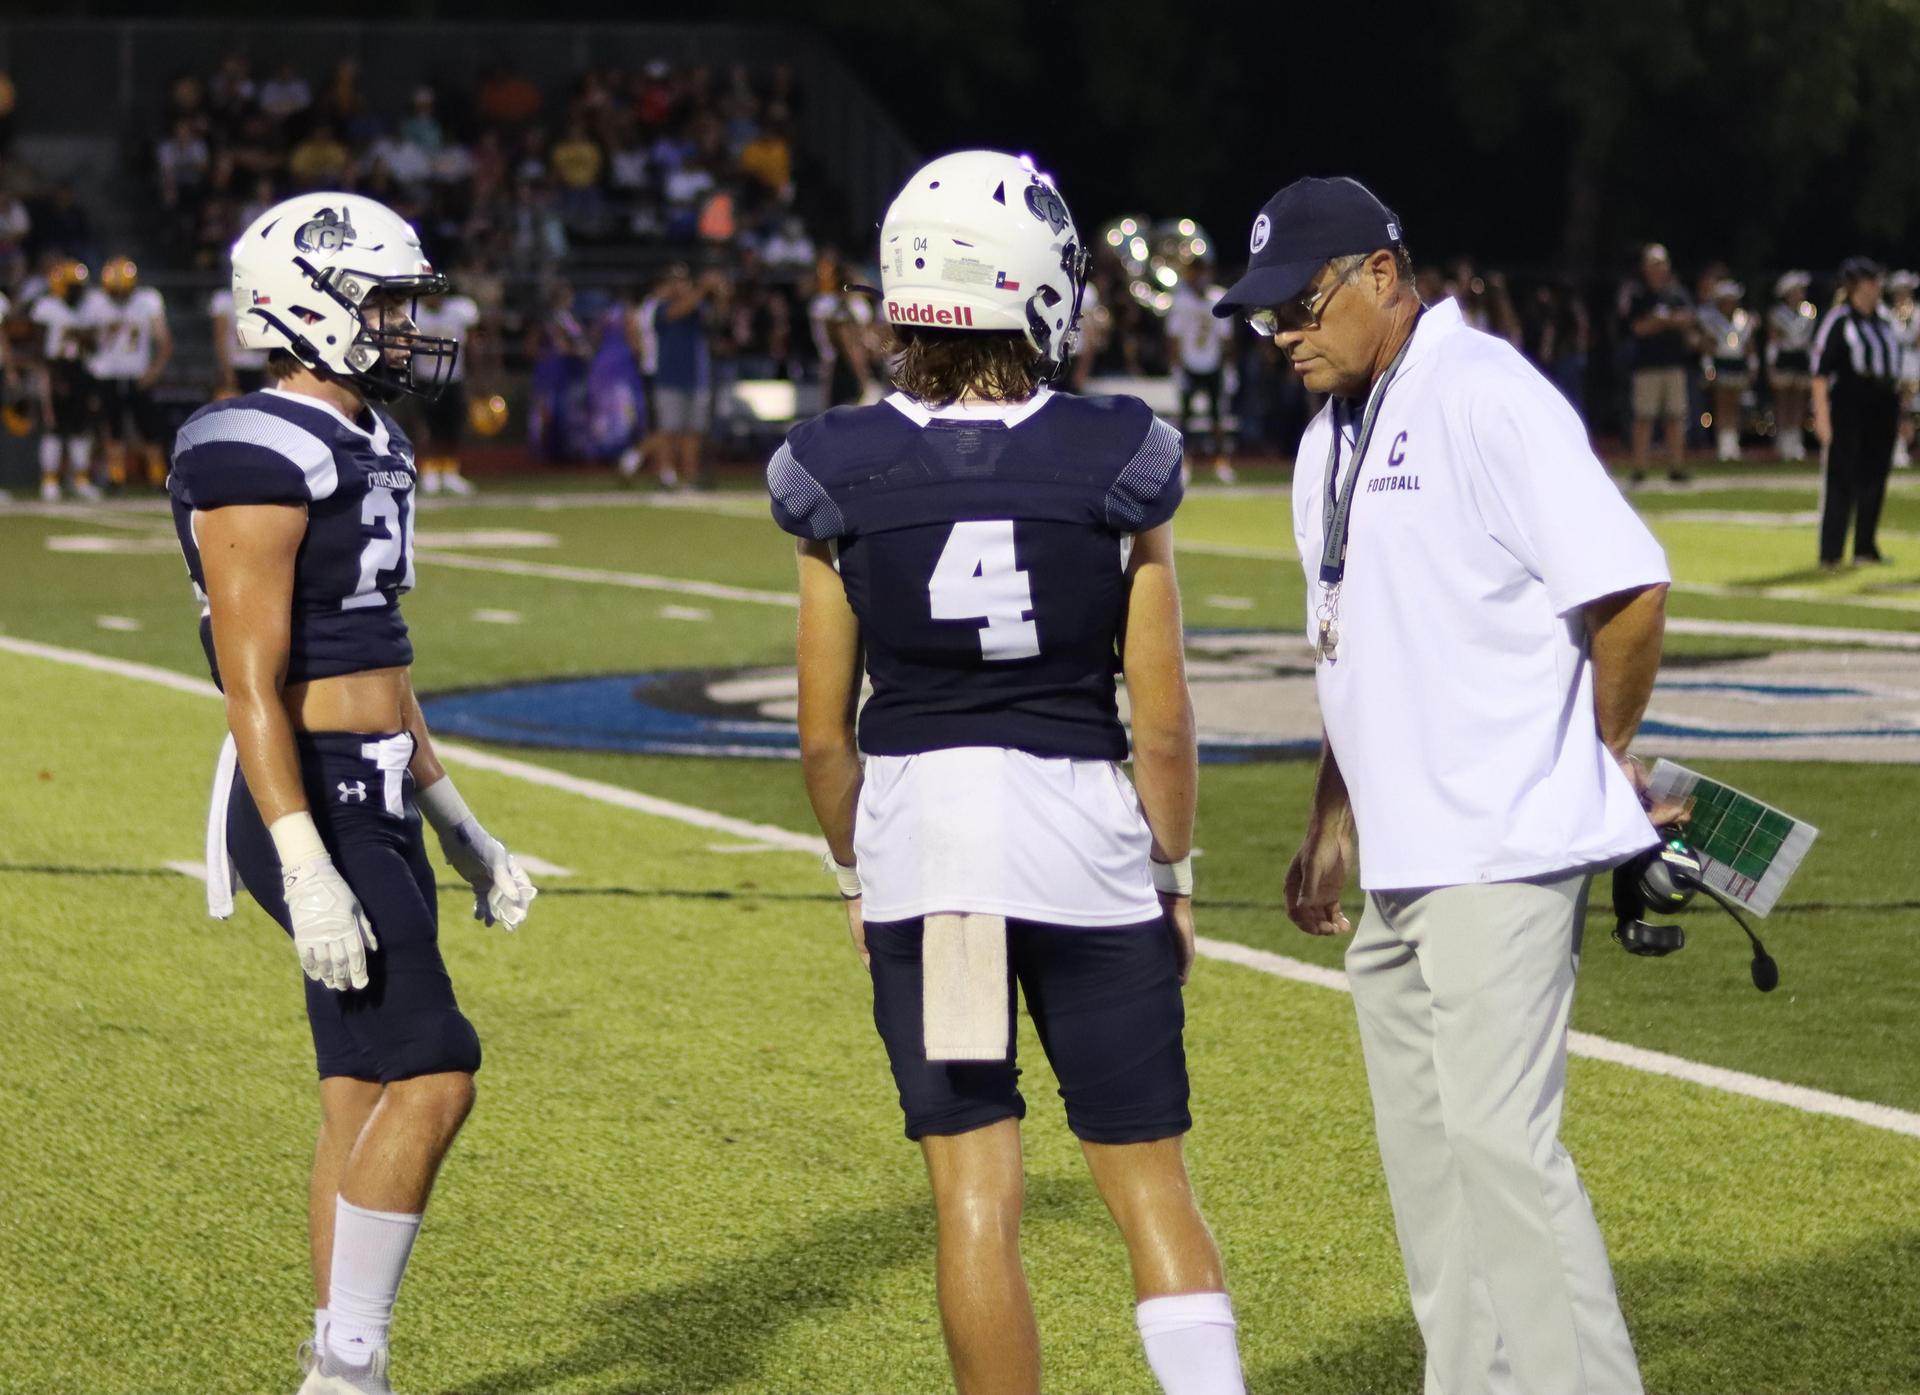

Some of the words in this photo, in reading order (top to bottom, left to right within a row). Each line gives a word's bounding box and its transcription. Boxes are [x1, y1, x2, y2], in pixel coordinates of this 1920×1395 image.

[320, 230, 336, 249] C
[913, 237, 928, 251] 04
[1253, 220, 1266, 247] C
[888, 301, 973, 327] Riddell
[1388, 430, 1408, 467] C
[1367, 475, 1421, 493] FOOTBALL
[928, 520, 1041, 661] 4
